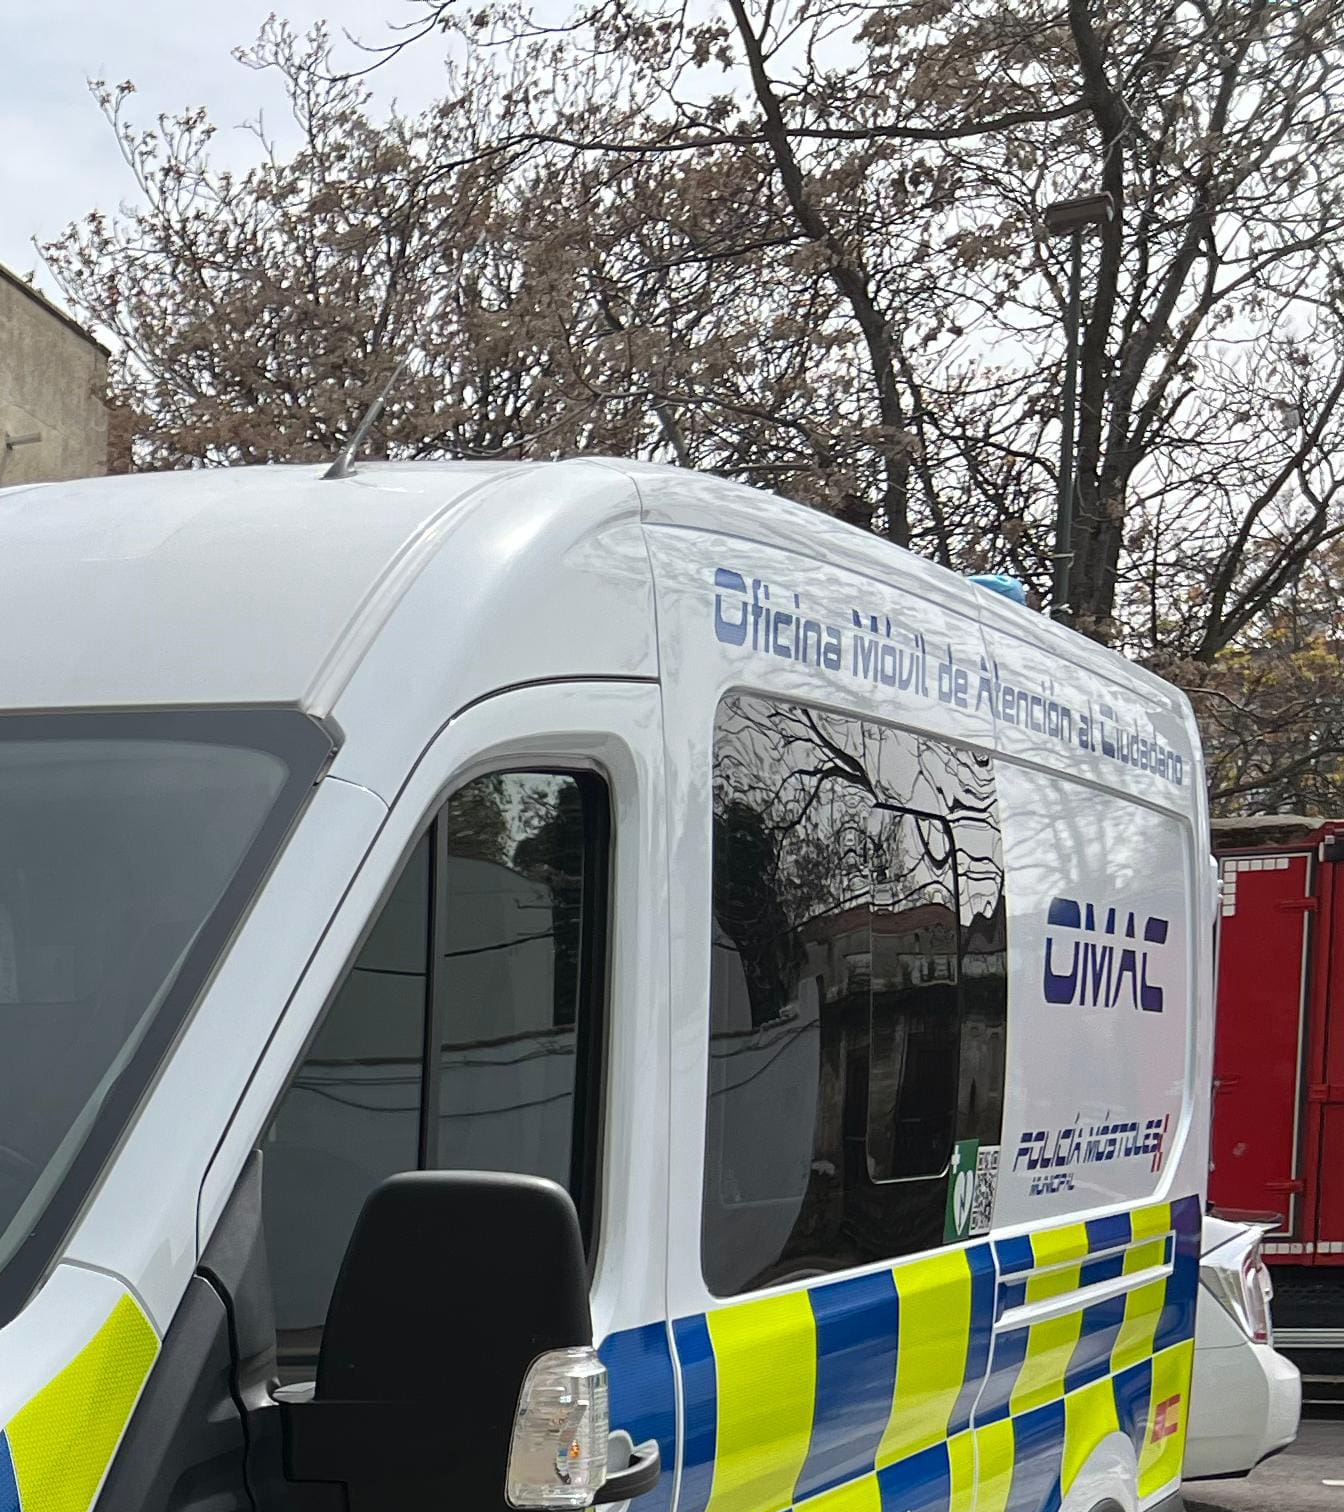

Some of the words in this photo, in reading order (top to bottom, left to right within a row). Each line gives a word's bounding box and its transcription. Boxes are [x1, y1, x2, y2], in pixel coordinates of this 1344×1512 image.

[714, 567, 842, 671] Oficina
[938, 642, 968, 709] de
[975, 655, 1072, 743] Atención
[1078, 700, 1096, 752] al
[1099, 702, 1183, 785] Ciudadano
[1043, 896, 1169, 1013] OMAC
[1013, 1112, 1083, 1173] POLICÍA
[1083, 1109, 1163, 1164] MÓSTOLES
